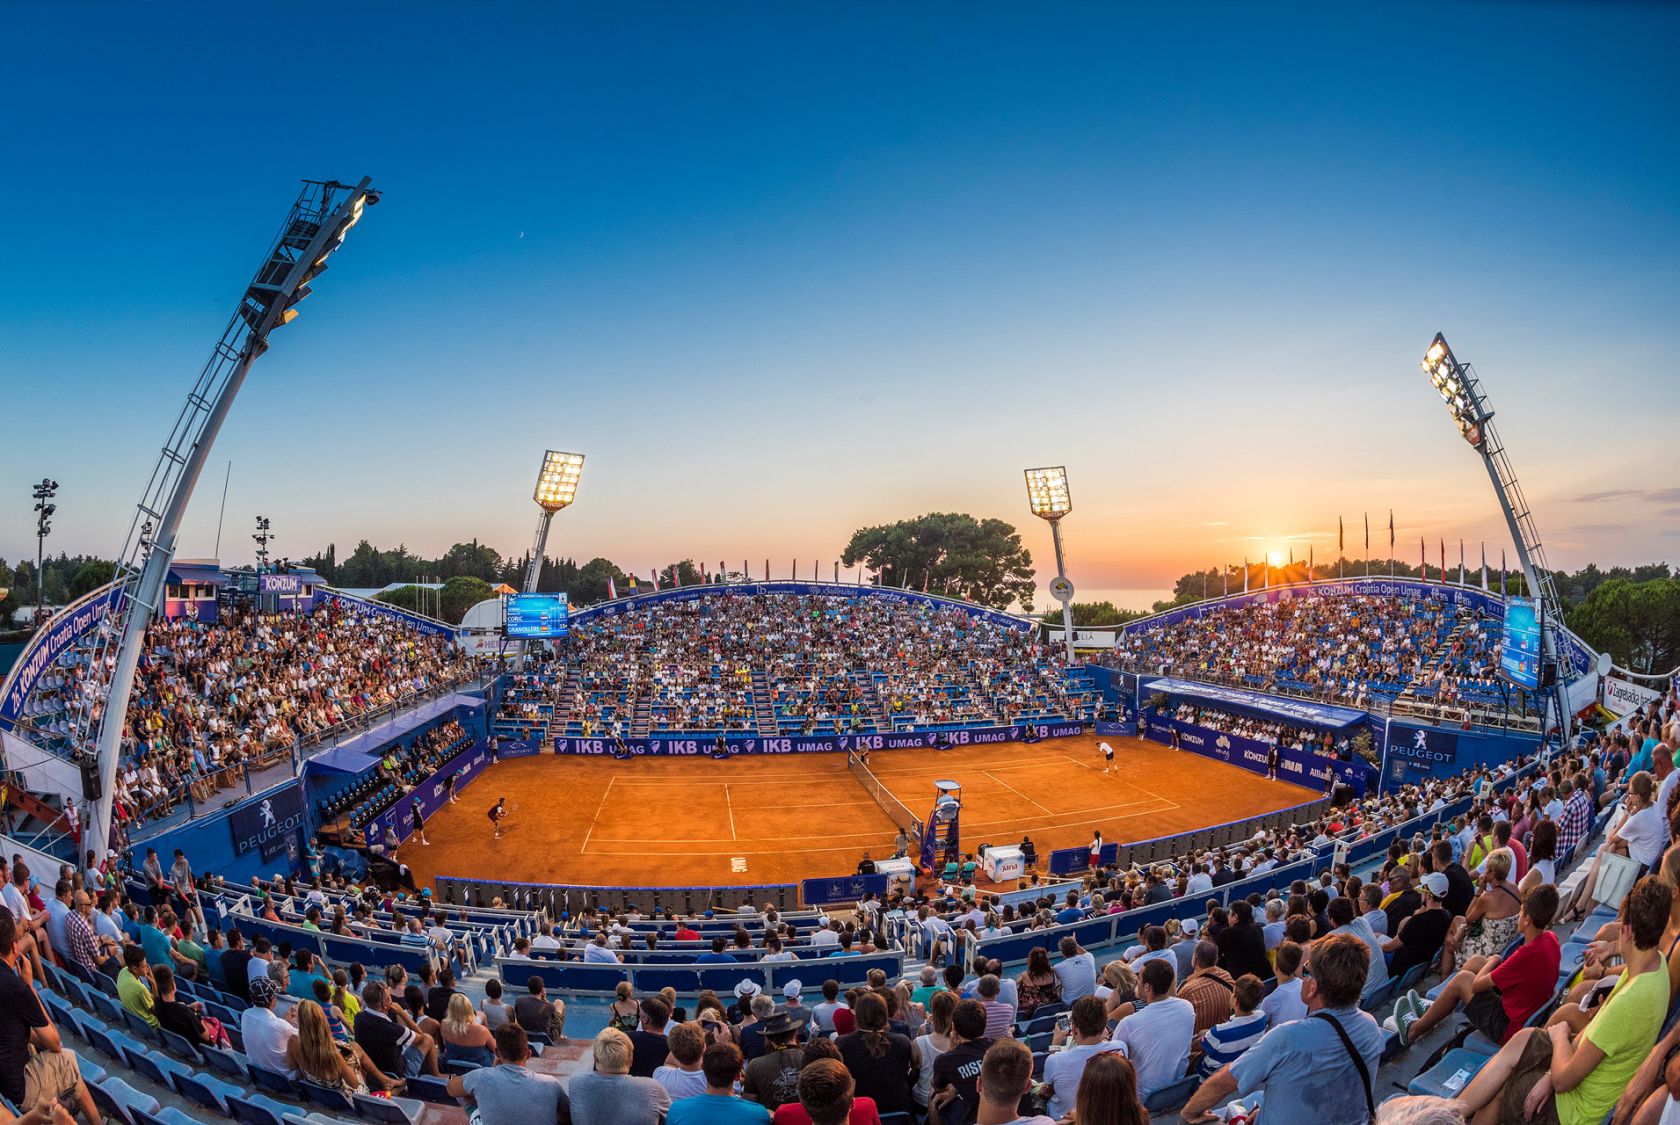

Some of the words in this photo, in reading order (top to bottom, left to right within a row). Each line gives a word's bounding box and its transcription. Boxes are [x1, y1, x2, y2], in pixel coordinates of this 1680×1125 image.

[265, 577, 297, 590] KONZUM
[1318, 585, 1354, 596] KONZUM
[1355, 584, 1380, 594] Croatia
[1381, 584, 1399, 596] Open
[1401, 586, 1421, 598] Umag
[338, 598, 370, 615] ONZUM
[397, 615, 416, 629] Oen
[20, 642, 49, 697] KONZUM
[50, 623, 73, 654] Croatia
[73, 612, 92, 635] Open
[1613, 683, 1639, 705] Zagrebačka
[949, 731, 969, 744] KB
[974, 733, 1006, 743] UMAG
[1052, 727, 1081, 737] UMAG
[576, 740, 604, 754] IKB
[609, 745, 645, 754] UAG
[668, 740, 697, 754] IKB
[763, 739, 791, 753] IKB
[797, 743, 833, 752] UMAG
[856, 736, 883, 749] IKB
[889, 738, 922, 748] UMAG
[1244, 750, 1269, 765] KONZU
[1390, 745, 1452, 762] PEUGEOT
[240, 813, 301, 854] PEUGEOT
